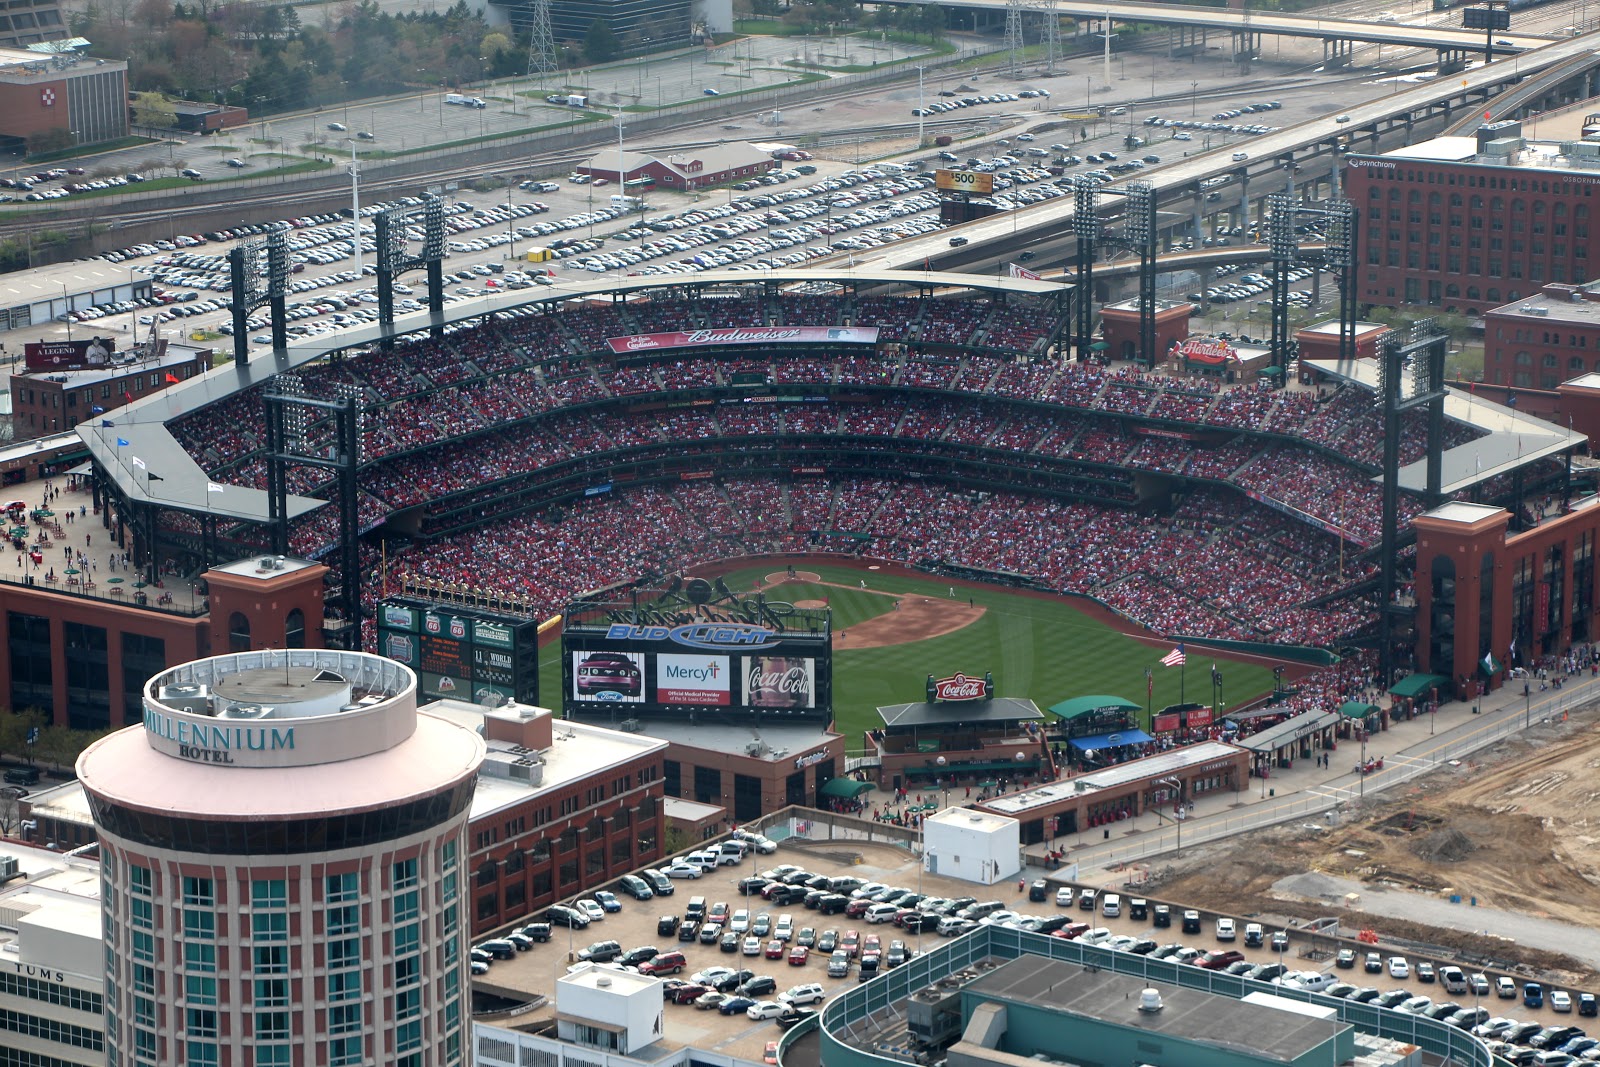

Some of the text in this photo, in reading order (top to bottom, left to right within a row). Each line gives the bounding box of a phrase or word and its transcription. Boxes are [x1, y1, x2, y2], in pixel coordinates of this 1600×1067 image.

[1359, 160, 1396, 169] asynchrony
[950, 173, 975, 184] $500
[682, 328, 800, 343] Budweiser
[627, 340, 659, 350] Cardinals
[428, 622, 438, 630] 66
[452, 627, 462, 635] 66
[605, 624, 776, 644] BUD LIGHT
[490, 652, 512, 663] WORLD
[666, 665, 708, 681] Mercy
[748, 666, 808, 694] Coca-Cola
[942, 682, 980, 697] Coca-Cola
[143, 704, 295, 750] MILLENNIUM
[179, 744, 234, 764] HOTEL
[15, 962, 64, 983] TUMS
